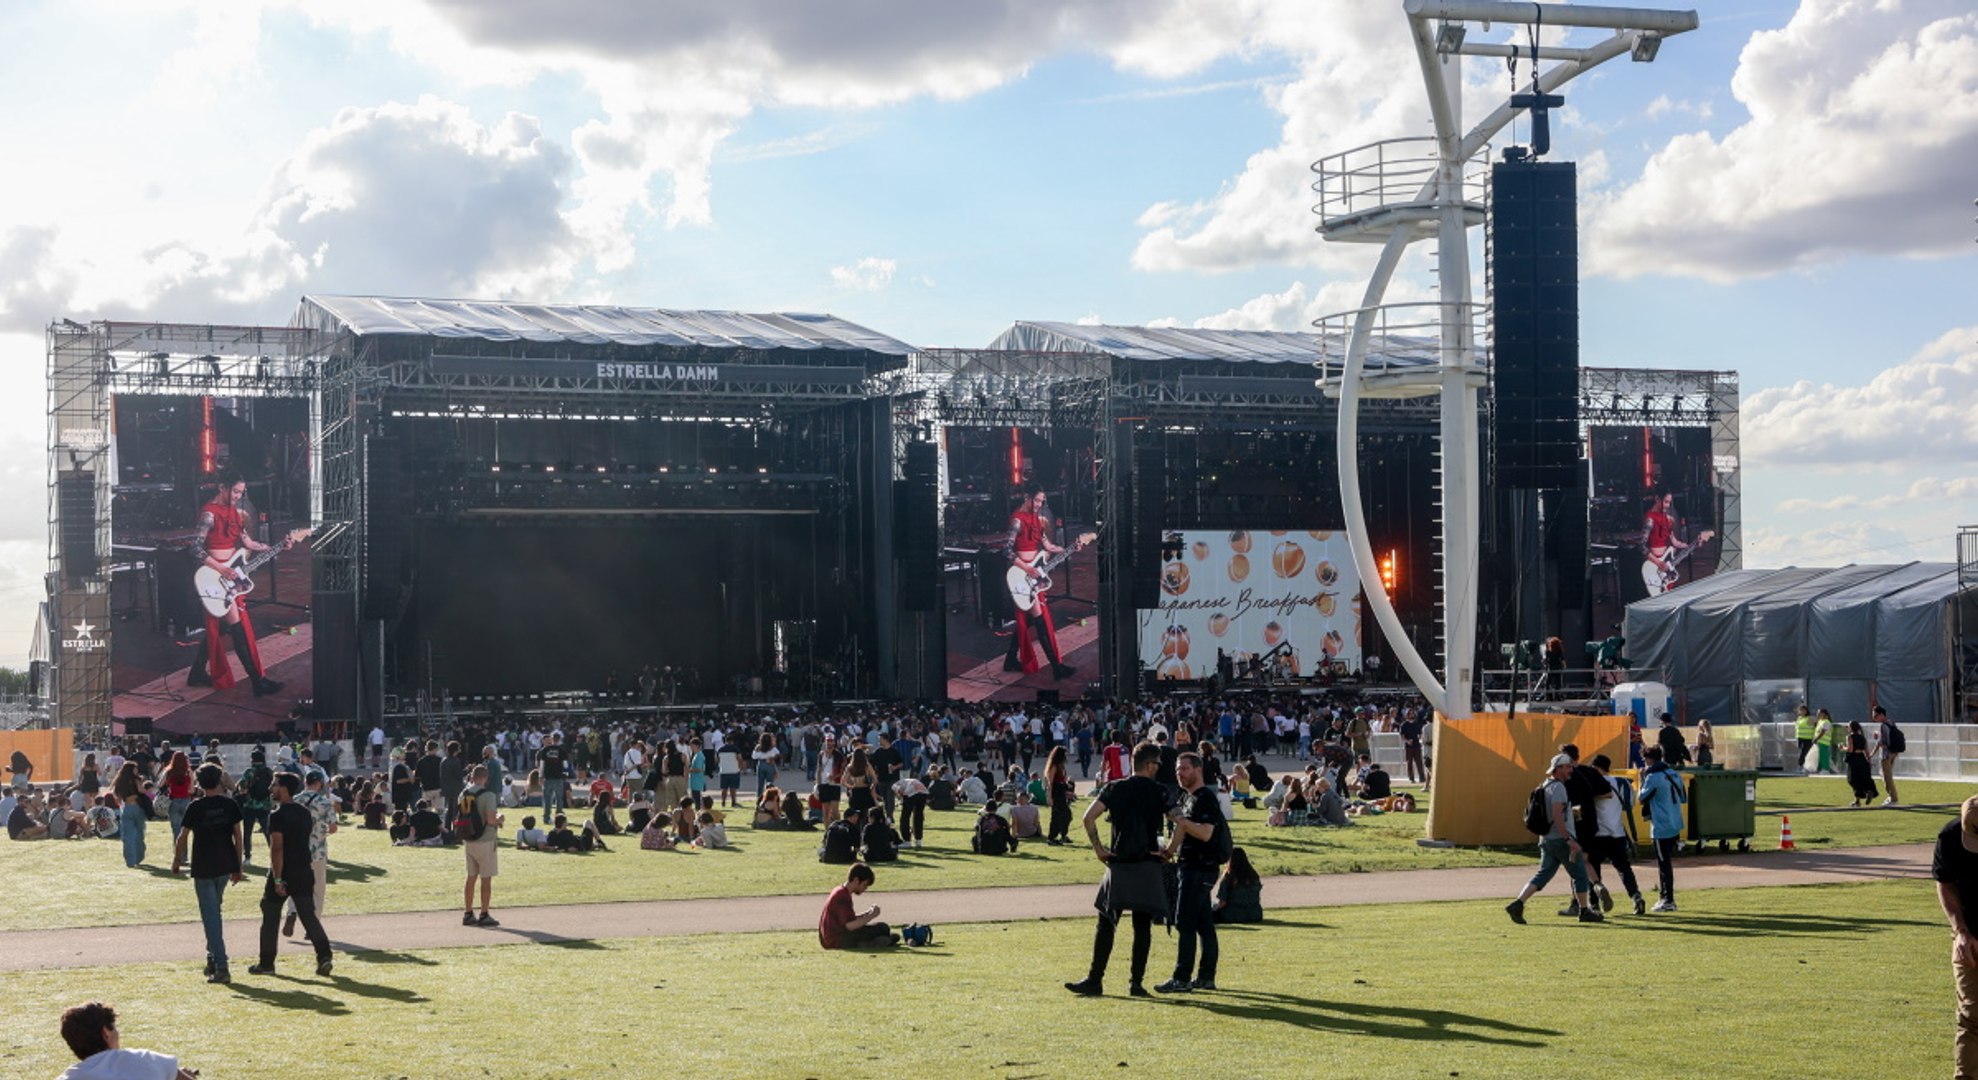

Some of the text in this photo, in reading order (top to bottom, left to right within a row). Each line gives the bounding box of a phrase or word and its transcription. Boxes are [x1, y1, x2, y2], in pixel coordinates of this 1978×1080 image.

[597, 363, 718, 380] ESTRELLA DAMM
[1231, 587, 1340, 621] Breakfast
[62, 639, 106, 648] ESTRELLA
